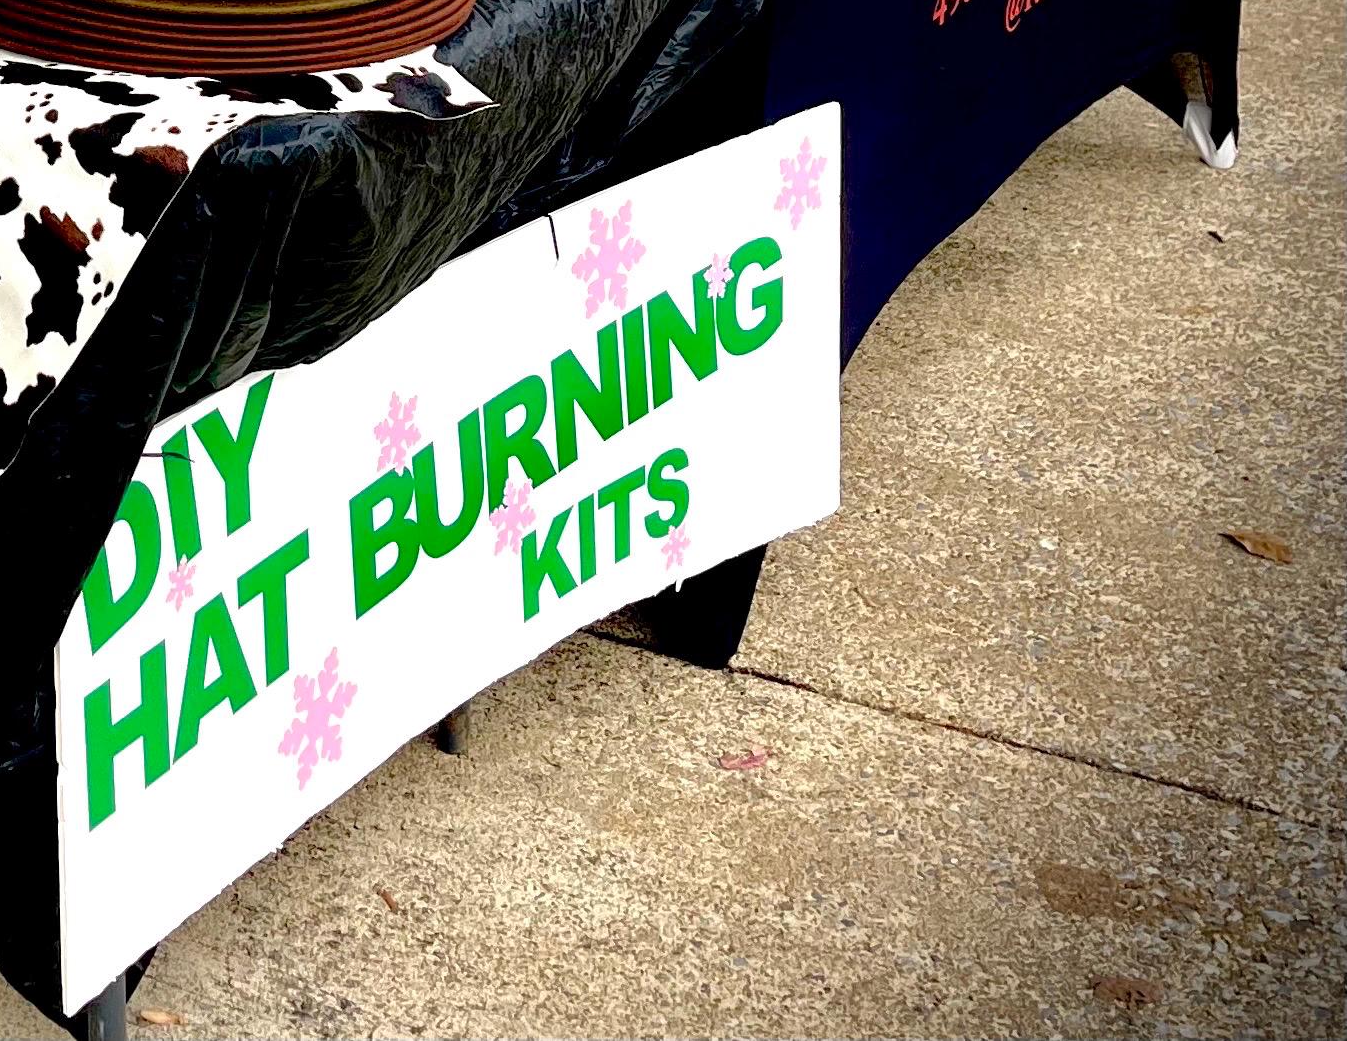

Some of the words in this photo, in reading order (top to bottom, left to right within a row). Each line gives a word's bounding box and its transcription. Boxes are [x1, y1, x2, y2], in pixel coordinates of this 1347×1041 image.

[82, 373, 277, 656] DIY
[83, 528, 311, 833] HAT
[349, 236, 785, 621] BURNING
[520, 447, 691, 623] KITS
